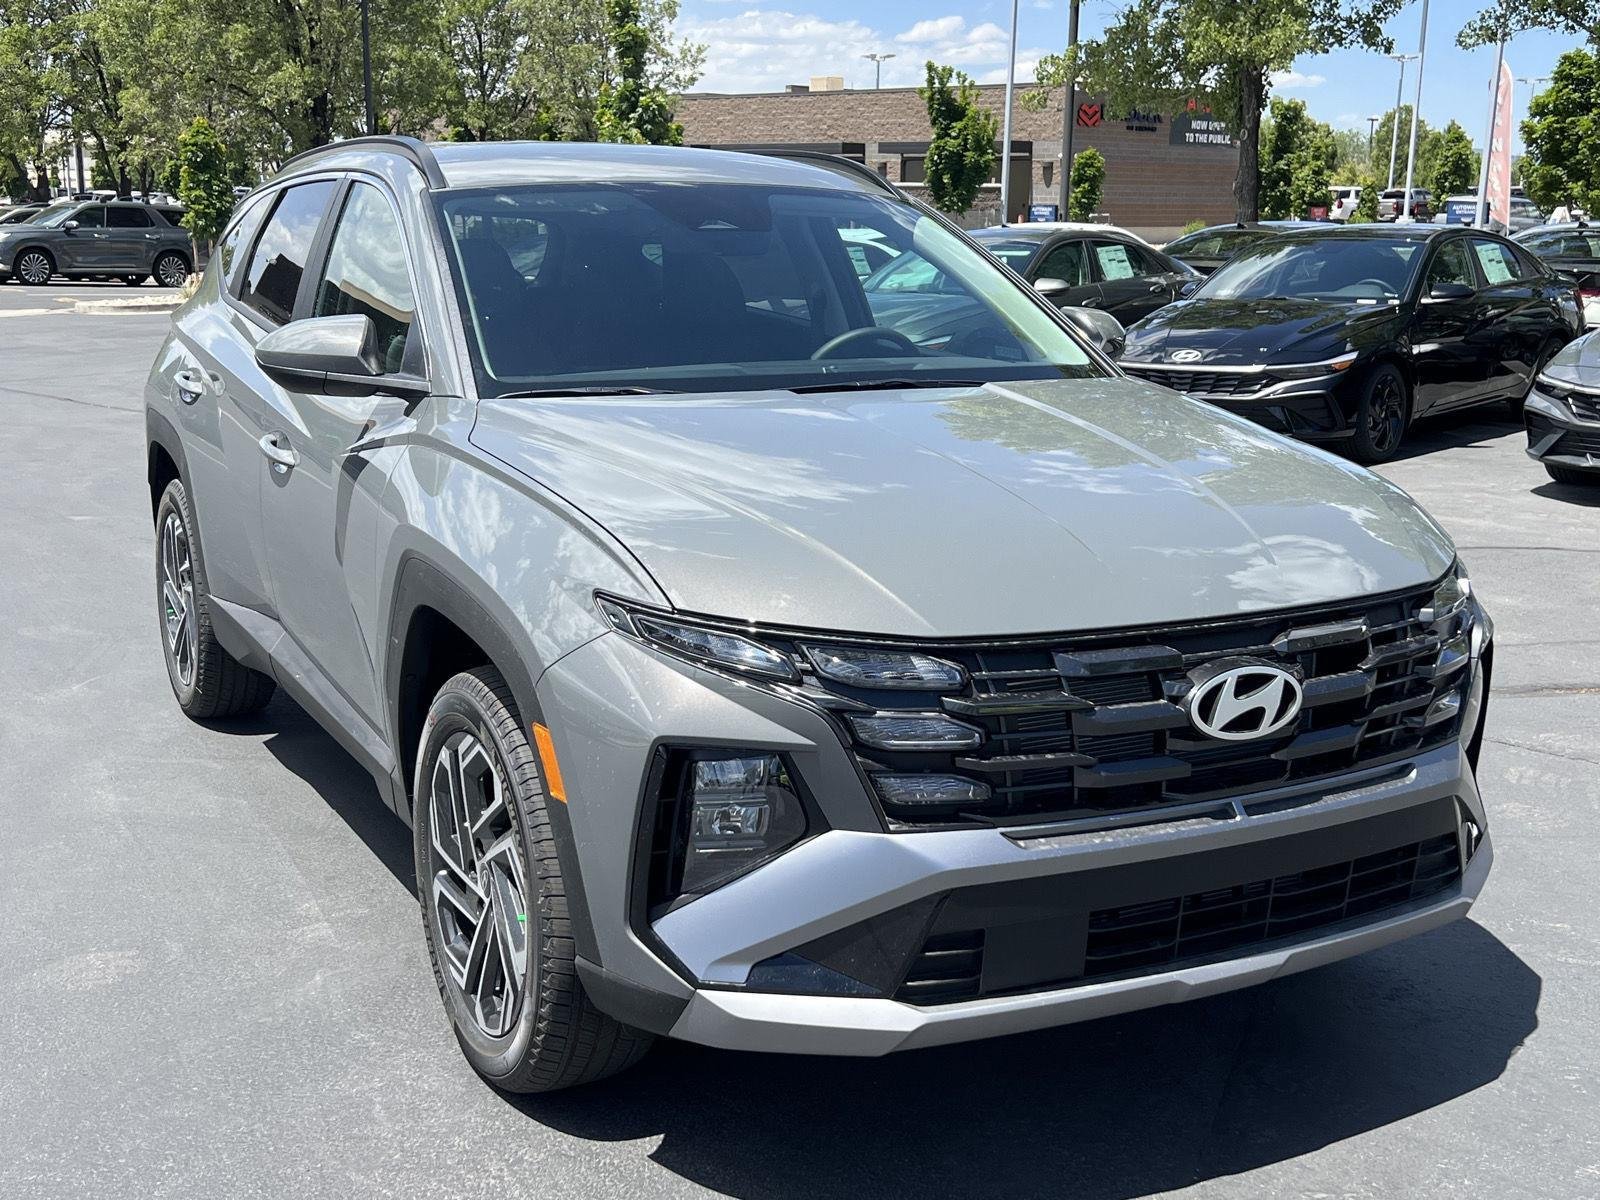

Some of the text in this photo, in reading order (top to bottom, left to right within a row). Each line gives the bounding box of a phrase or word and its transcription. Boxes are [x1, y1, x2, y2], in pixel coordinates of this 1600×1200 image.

[1191, 120, 1208, 130] NOW
[1185, 133, 1231, 144] TO THE PUBLIC
